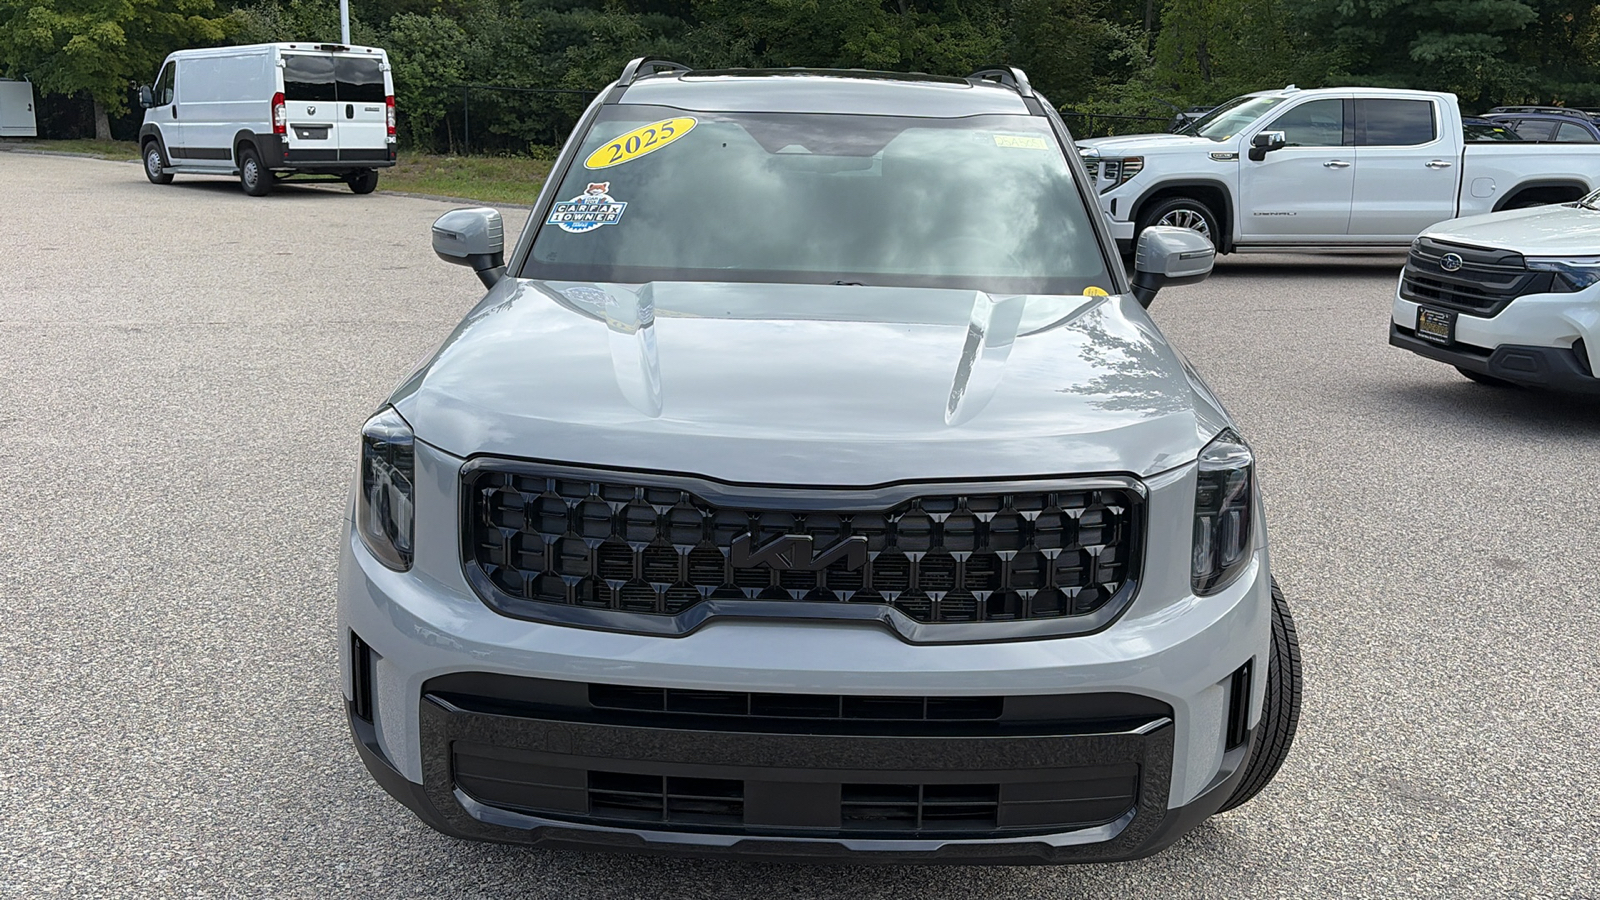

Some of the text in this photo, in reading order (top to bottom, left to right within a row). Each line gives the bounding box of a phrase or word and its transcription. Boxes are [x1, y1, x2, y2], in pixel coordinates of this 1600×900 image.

[607, 121, 675, 163] 2025
[557, 205, 619, 213] CARFAX
[731, 532, 868, 571] KIA
